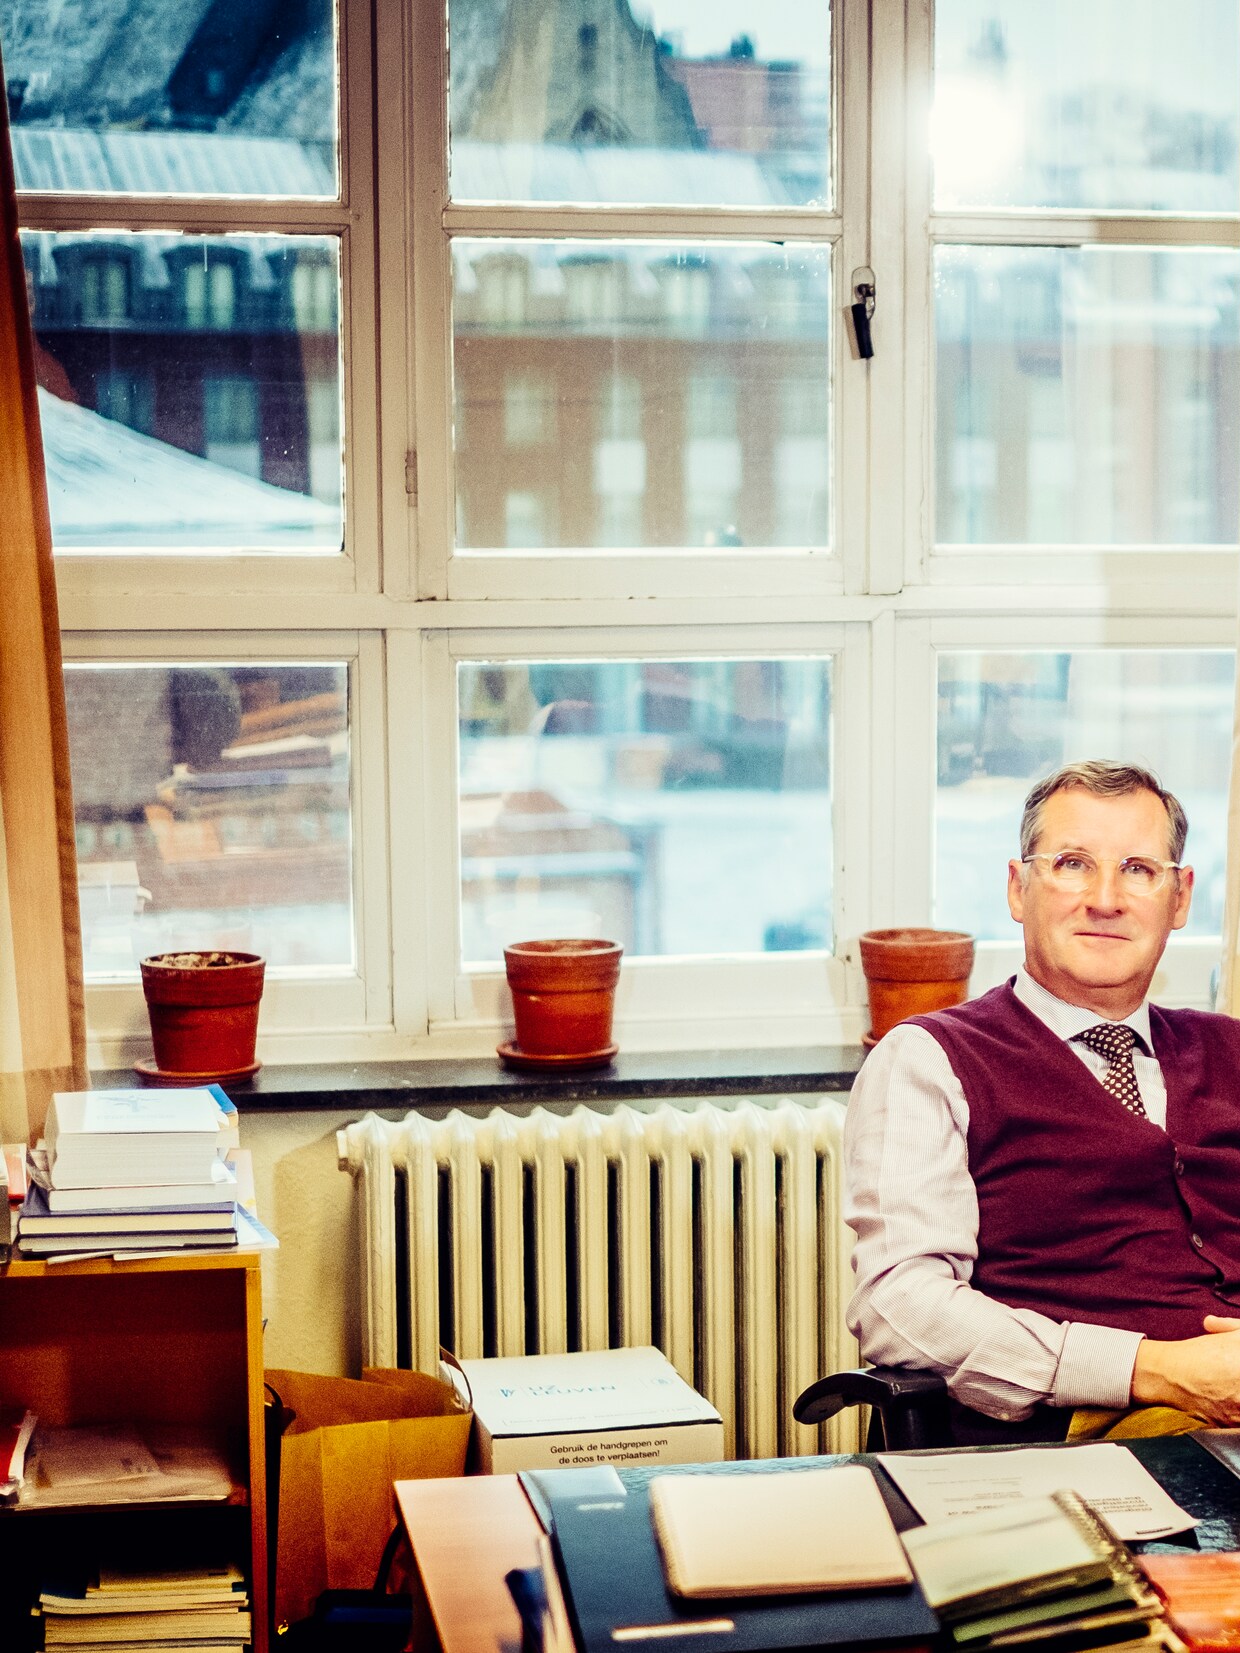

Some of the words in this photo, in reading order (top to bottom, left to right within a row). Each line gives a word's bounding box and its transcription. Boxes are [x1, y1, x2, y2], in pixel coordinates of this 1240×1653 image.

[550, 1445, 584, 1454] Gebruik
[600, 1441, 652, 1451] handgrepen
[559, 1456, 570, 1464] de
[573, 1455, 594, 1464] doos
[607, 1450, 660, 1461] verplaatsen!
